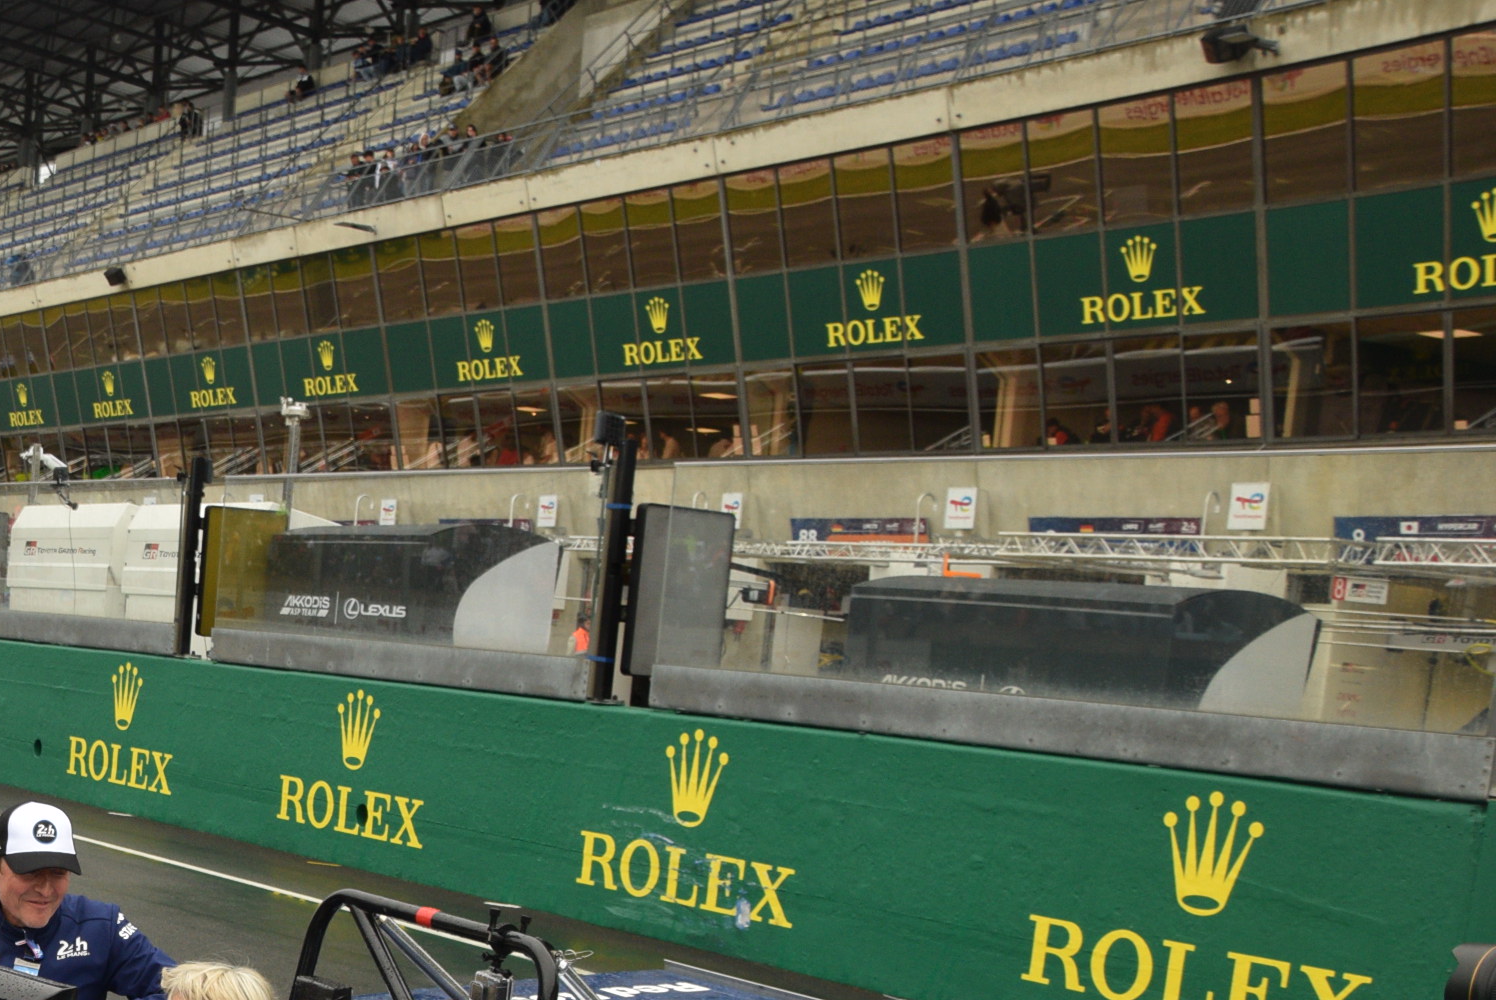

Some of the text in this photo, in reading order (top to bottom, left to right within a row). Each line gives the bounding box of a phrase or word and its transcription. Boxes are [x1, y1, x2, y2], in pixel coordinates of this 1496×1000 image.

[1080, 285, 1207, 325] ROLEX
[825, 313, 925, 348] ROLEX
[622, 336, 704, 366] ROLEX
[456, 355, 524, 382] ROLEX
[303, 372, 359, 397] ROLEX
[92, 399, 134, 419] ROLEX
[190, 387, 237, 408] ROLEX
[9, 409, 44, 427] ROLEX
[1333, 578, 1344, 600] 8
[360, 603, 407, 618] LEXUS
[66, 735, 173, 796] ROLEX
[276, 774, 425, 849] ROLEX
[37, 823, 55, 835] 24h
[575, 829, 797, 929] ROLEX
[57, 937, 88, 957] 24h
[67, 950, 87, 959] MANS
